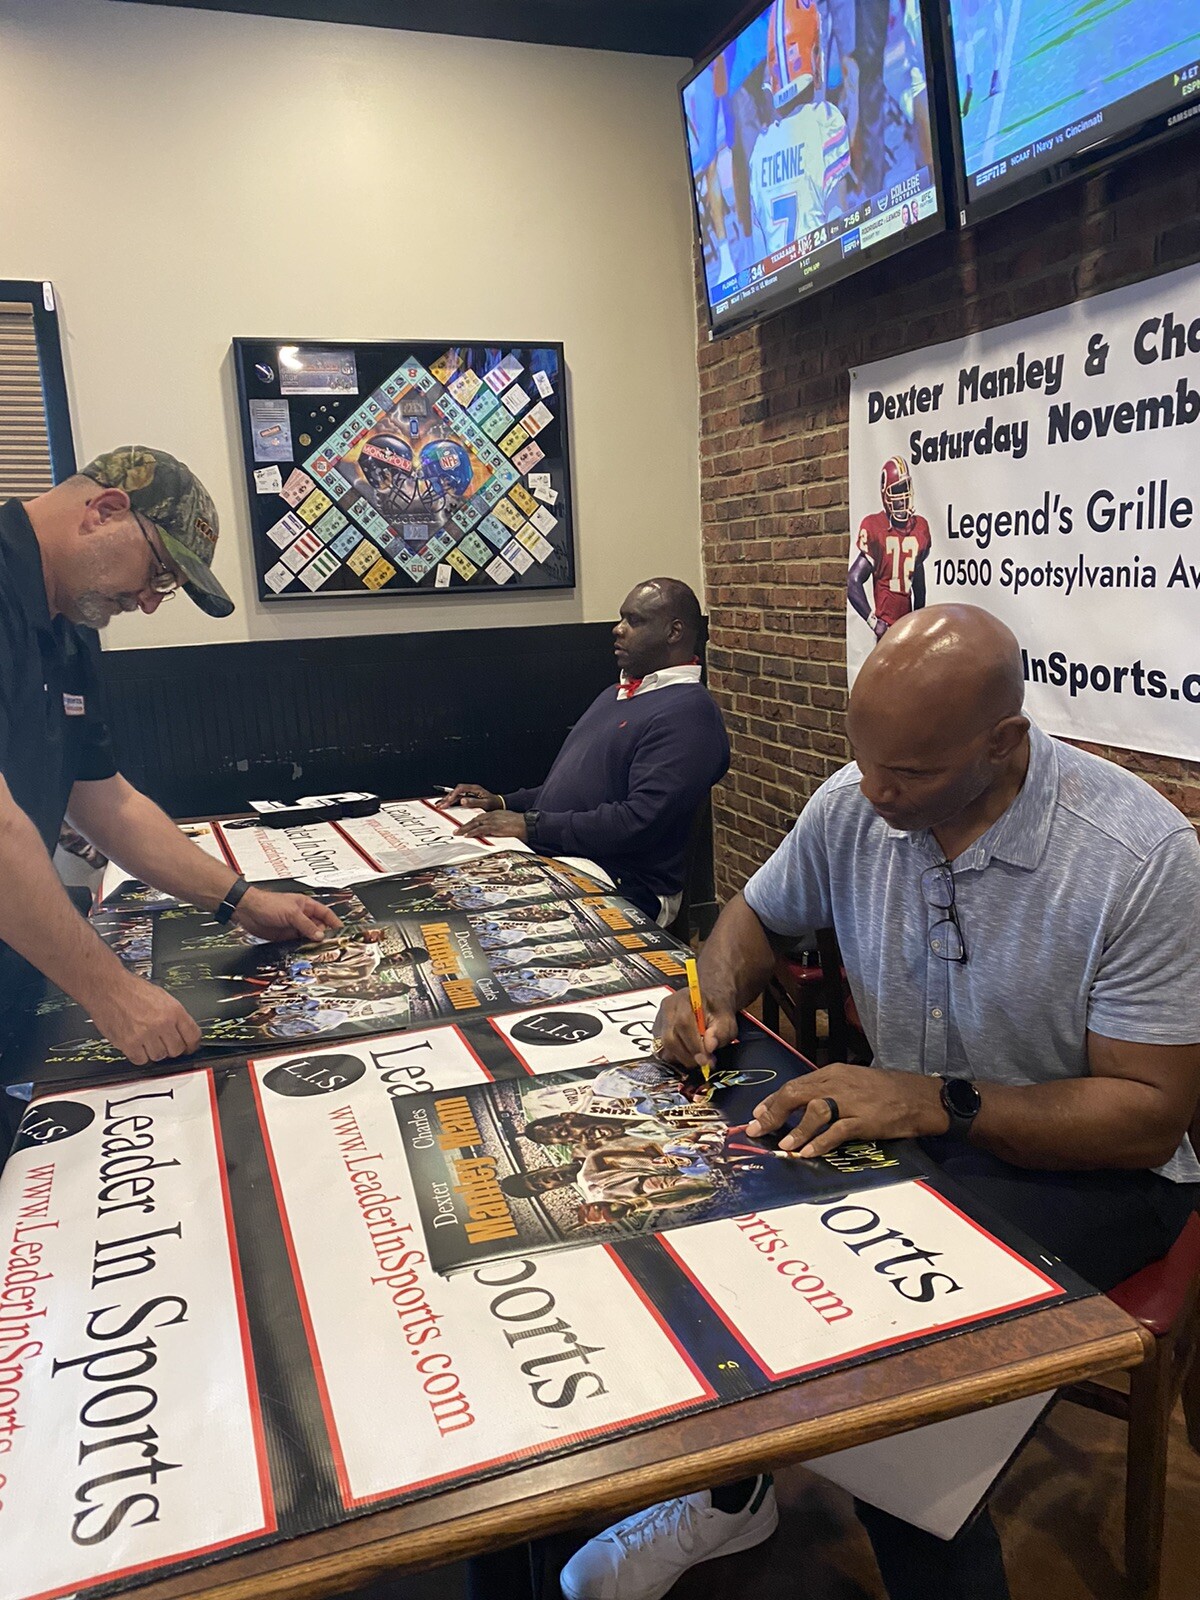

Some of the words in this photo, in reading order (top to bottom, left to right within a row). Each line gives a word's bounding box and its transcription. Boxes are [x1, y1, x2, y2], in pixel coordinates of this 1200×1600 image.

[1036, 137, 1053, 155] Navy
[1055, 134, 1064, 144] vs
[1065, 112, 1103, 138] Cincinnati
[761, 143, 805, 188] ETIENNE
[890, 173, 920, 199] COLLEGE
[814, 228, 828, 248] 24
[843, 212, 860, 229] 7:56
[868, 383, 944, 424] Dexter
[958, 352, 1065, 405] Manley
[1084, 333, 1110, 377] &
[909, 416, 1029, 466] Saturday
[1048, 377, 1200, 446] Novemb
[947, 490, 1074, 550] Legend's
[1086, 479, 1194, 533] Grille
[934, 558, 993, 586] 10500
[999, 553, 1157, 596] Spotsylvania
[454, 930, 475, 960] Dexter
[523, 1015, 589, 1042] L.I.S.
[281, 1060, 348, 1092] L.I.S.
[408, 1108, 435, 1150] Charles
[434, 1095, 484, 1151] Mann
[96, 1088, 182, 1220] Leader
[432, 1181, 459, 1230] Dexter
[453, 1156, 519, 1245] Manley
[91, 1220, 184, 1291] In
[327, 1104, 476, 1438] www.LeaderInSports.com
[804, 1195, 964, 1303] orts
[51, 1294, 189, 1548] Sports
